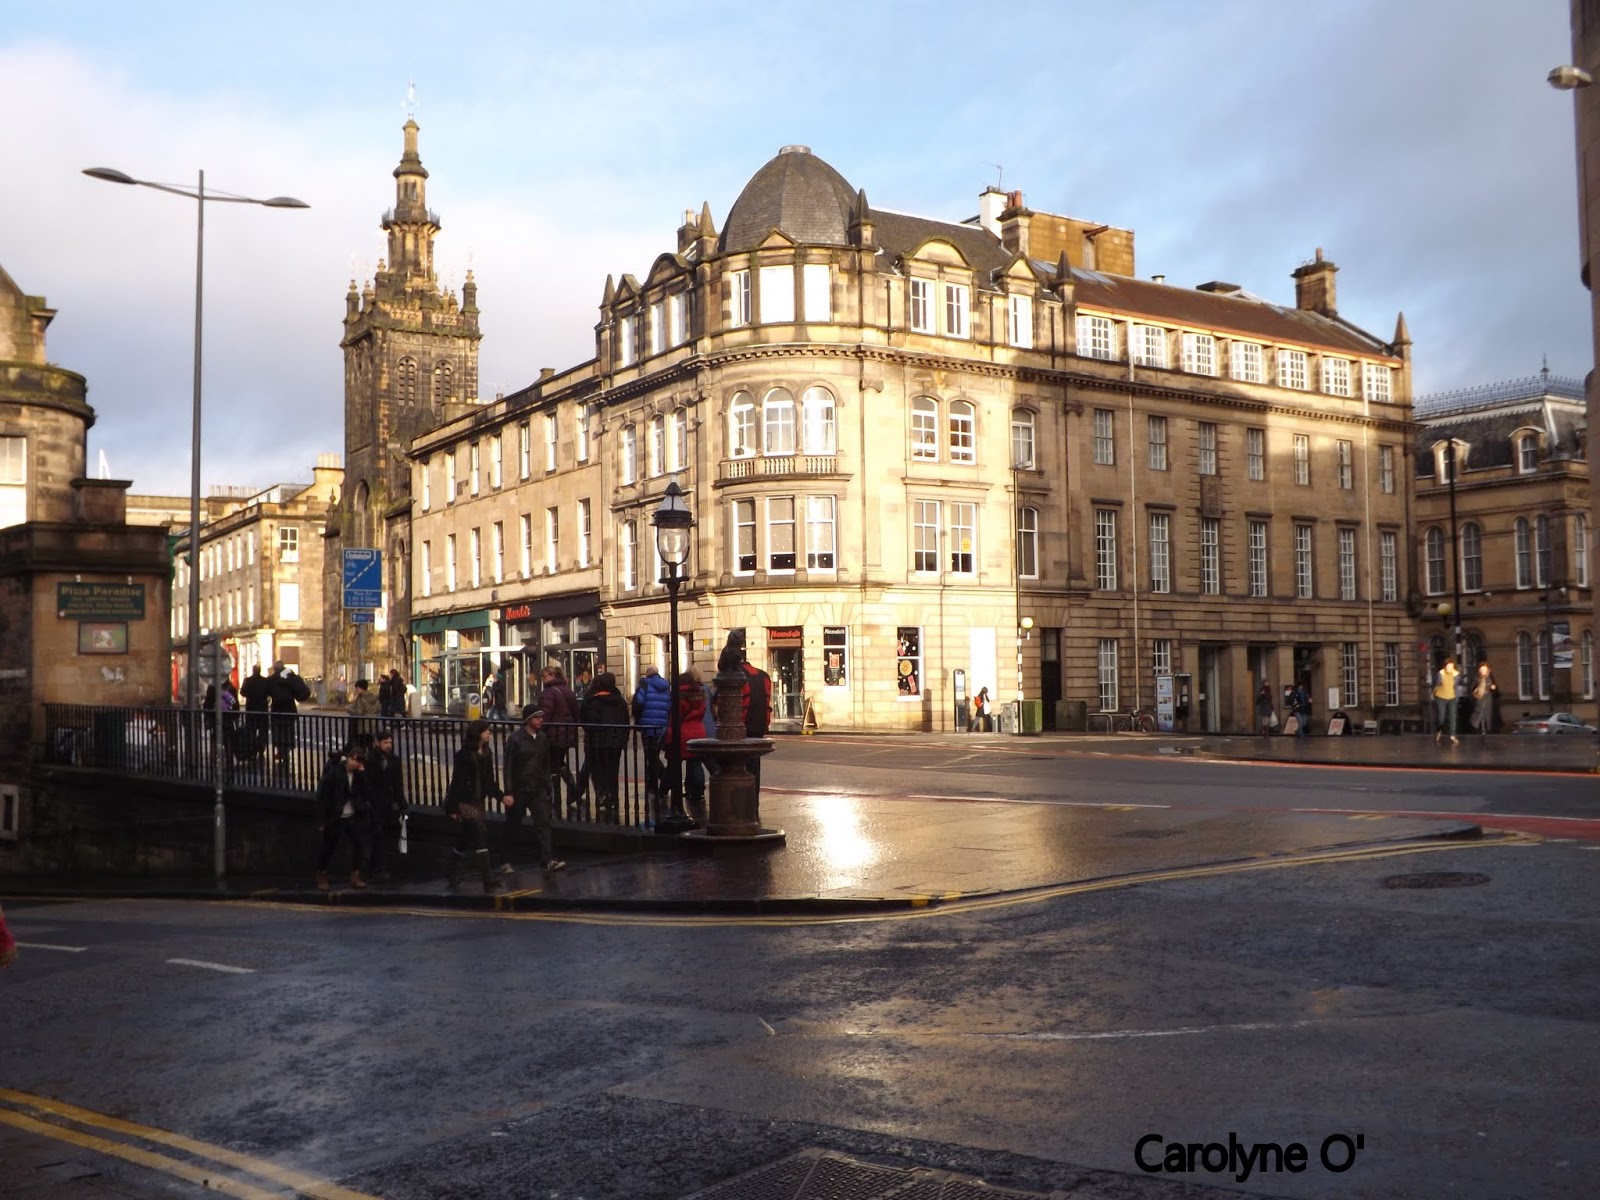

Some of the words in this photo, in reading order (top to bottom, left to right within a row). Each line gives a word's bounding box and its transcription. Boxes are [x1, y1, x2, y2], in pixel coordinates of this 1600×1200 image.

[61, 585, 90, 595] Pizza
[93, 585, 142, 596] Paradise
[770, 629, 801, 638] Nando's
